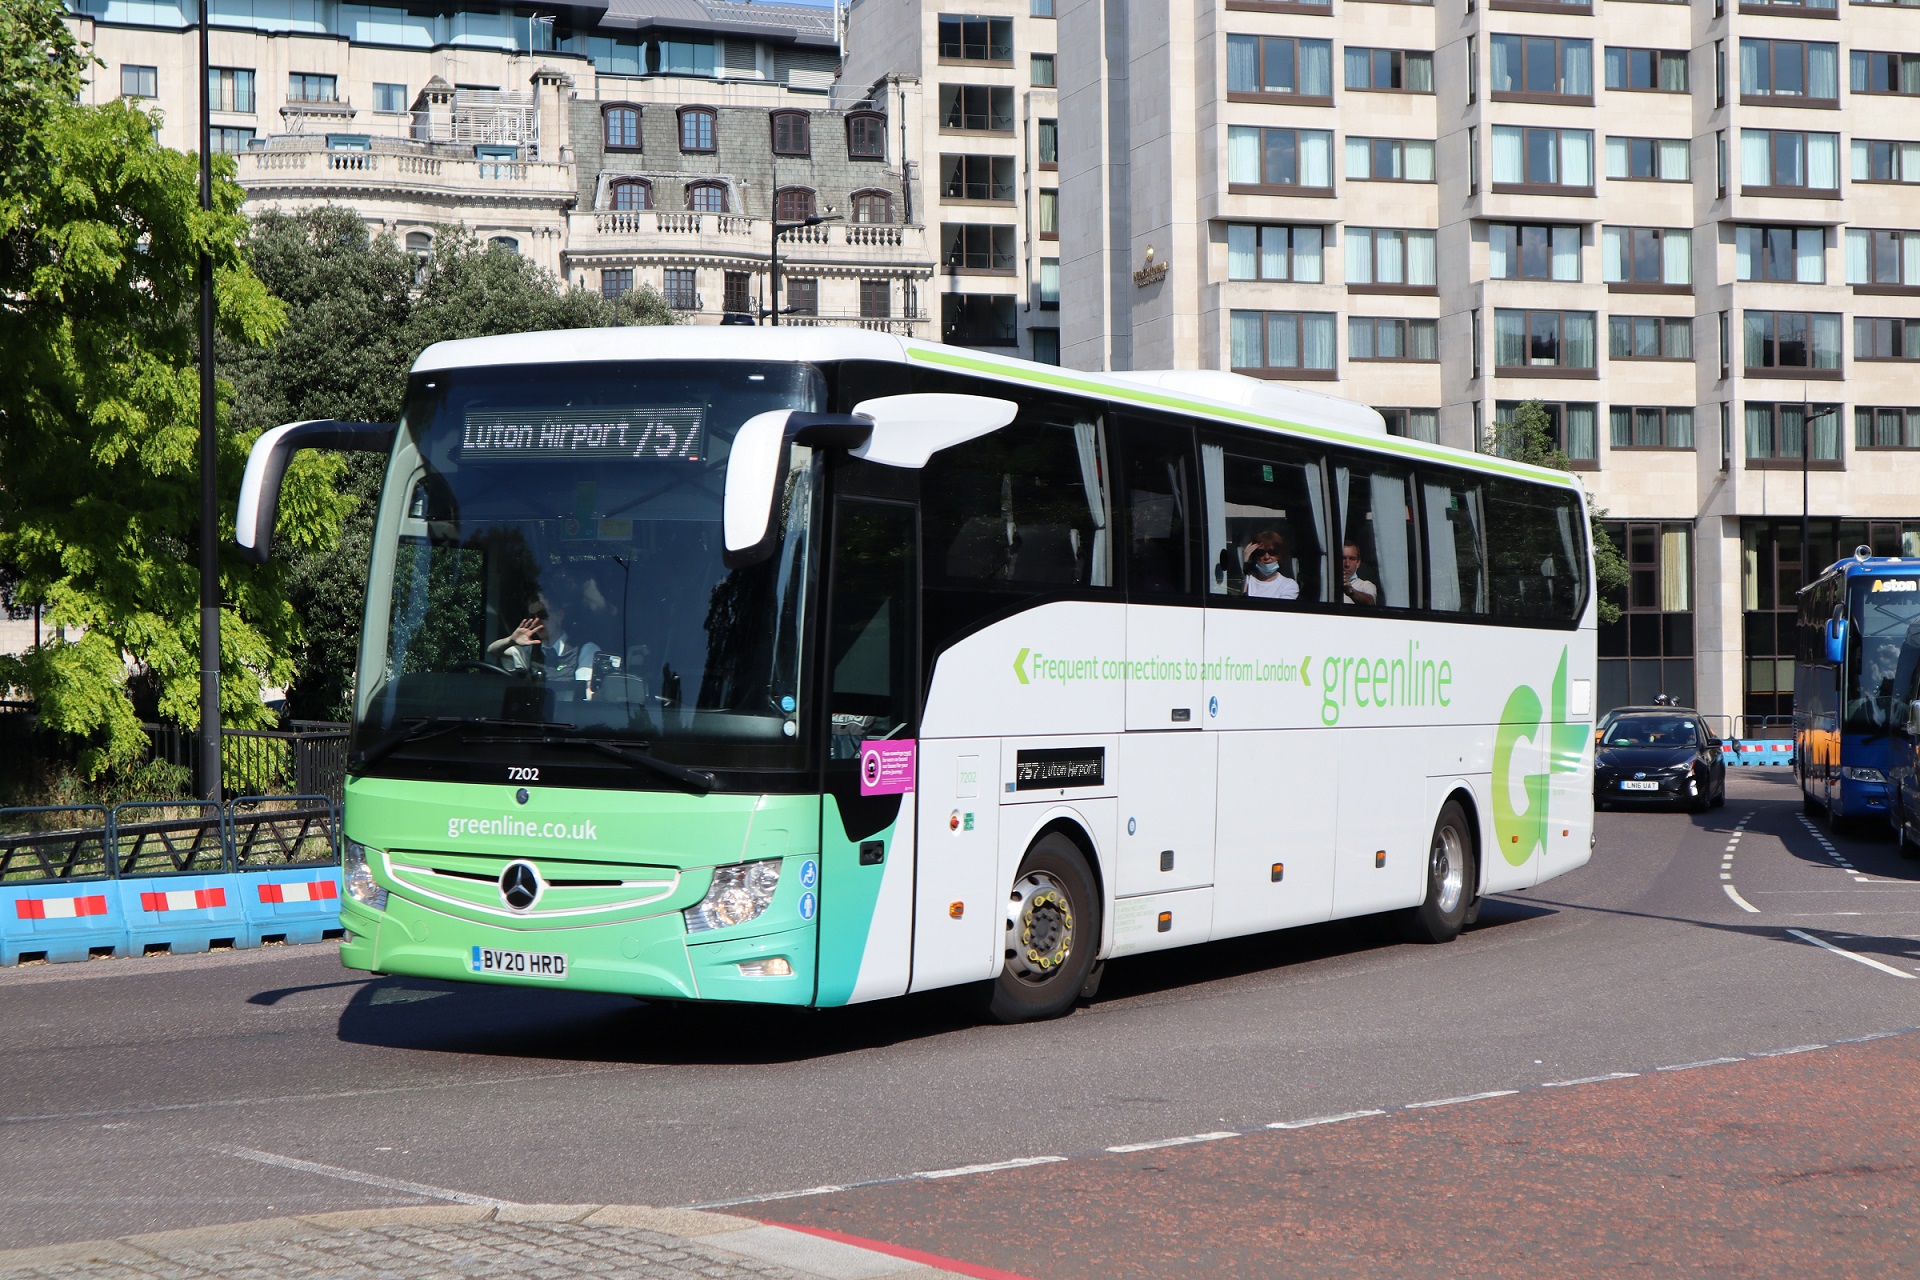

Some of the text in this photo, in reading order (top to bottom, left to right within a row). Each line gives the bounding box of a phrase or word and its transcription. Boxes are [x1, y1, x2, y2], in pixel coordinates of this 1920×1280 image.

[463, 417, 533, 448] Luton
[538, 415, 629, 449] Airport
[1871, 578, 1917, 593] Aston
[1033, 653, 1297, 686] Frequent connections to and from London
[1321, 639, 1452, 726] greenline
[507, 767, 539, 781] 7202
[960, 771, 976, 783] 7202
[1018, 760, 1098, 779] 757 Luton Airport
[447, 815, 597, 840] greenline.co.uk
[484, 950, 564, 974] BV20 HRD
